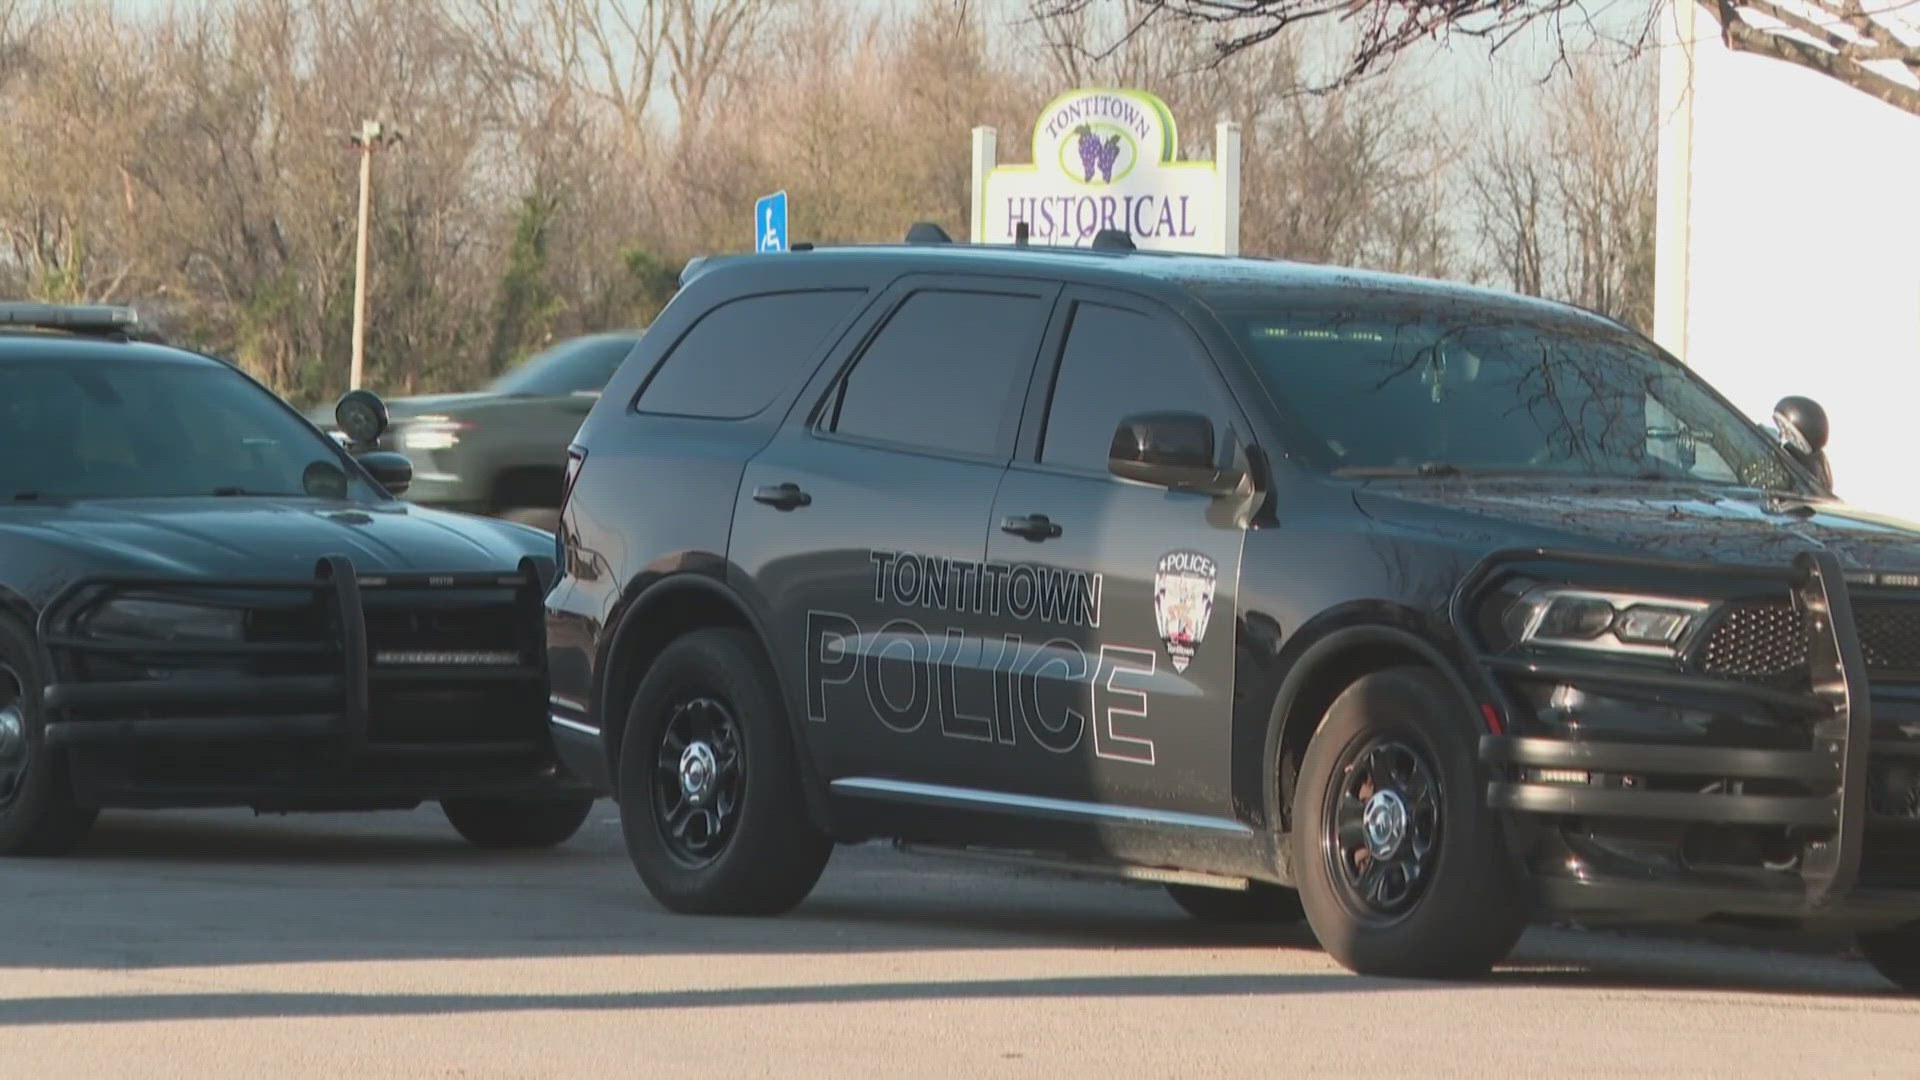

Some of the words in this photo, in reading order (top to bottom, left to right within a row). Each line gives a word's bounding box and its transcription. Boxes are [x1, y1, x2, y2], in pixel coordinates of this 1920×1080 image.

[1046, 95, 1150, 140] TONTITOWN
[1007, 195, 1196, 238] HISTORICAL
[1167, 553, 1211, 576] POLICE
[870, 549, 1103, 628] TONTITOWN
[805, 609, 1156, 765] POLICE
